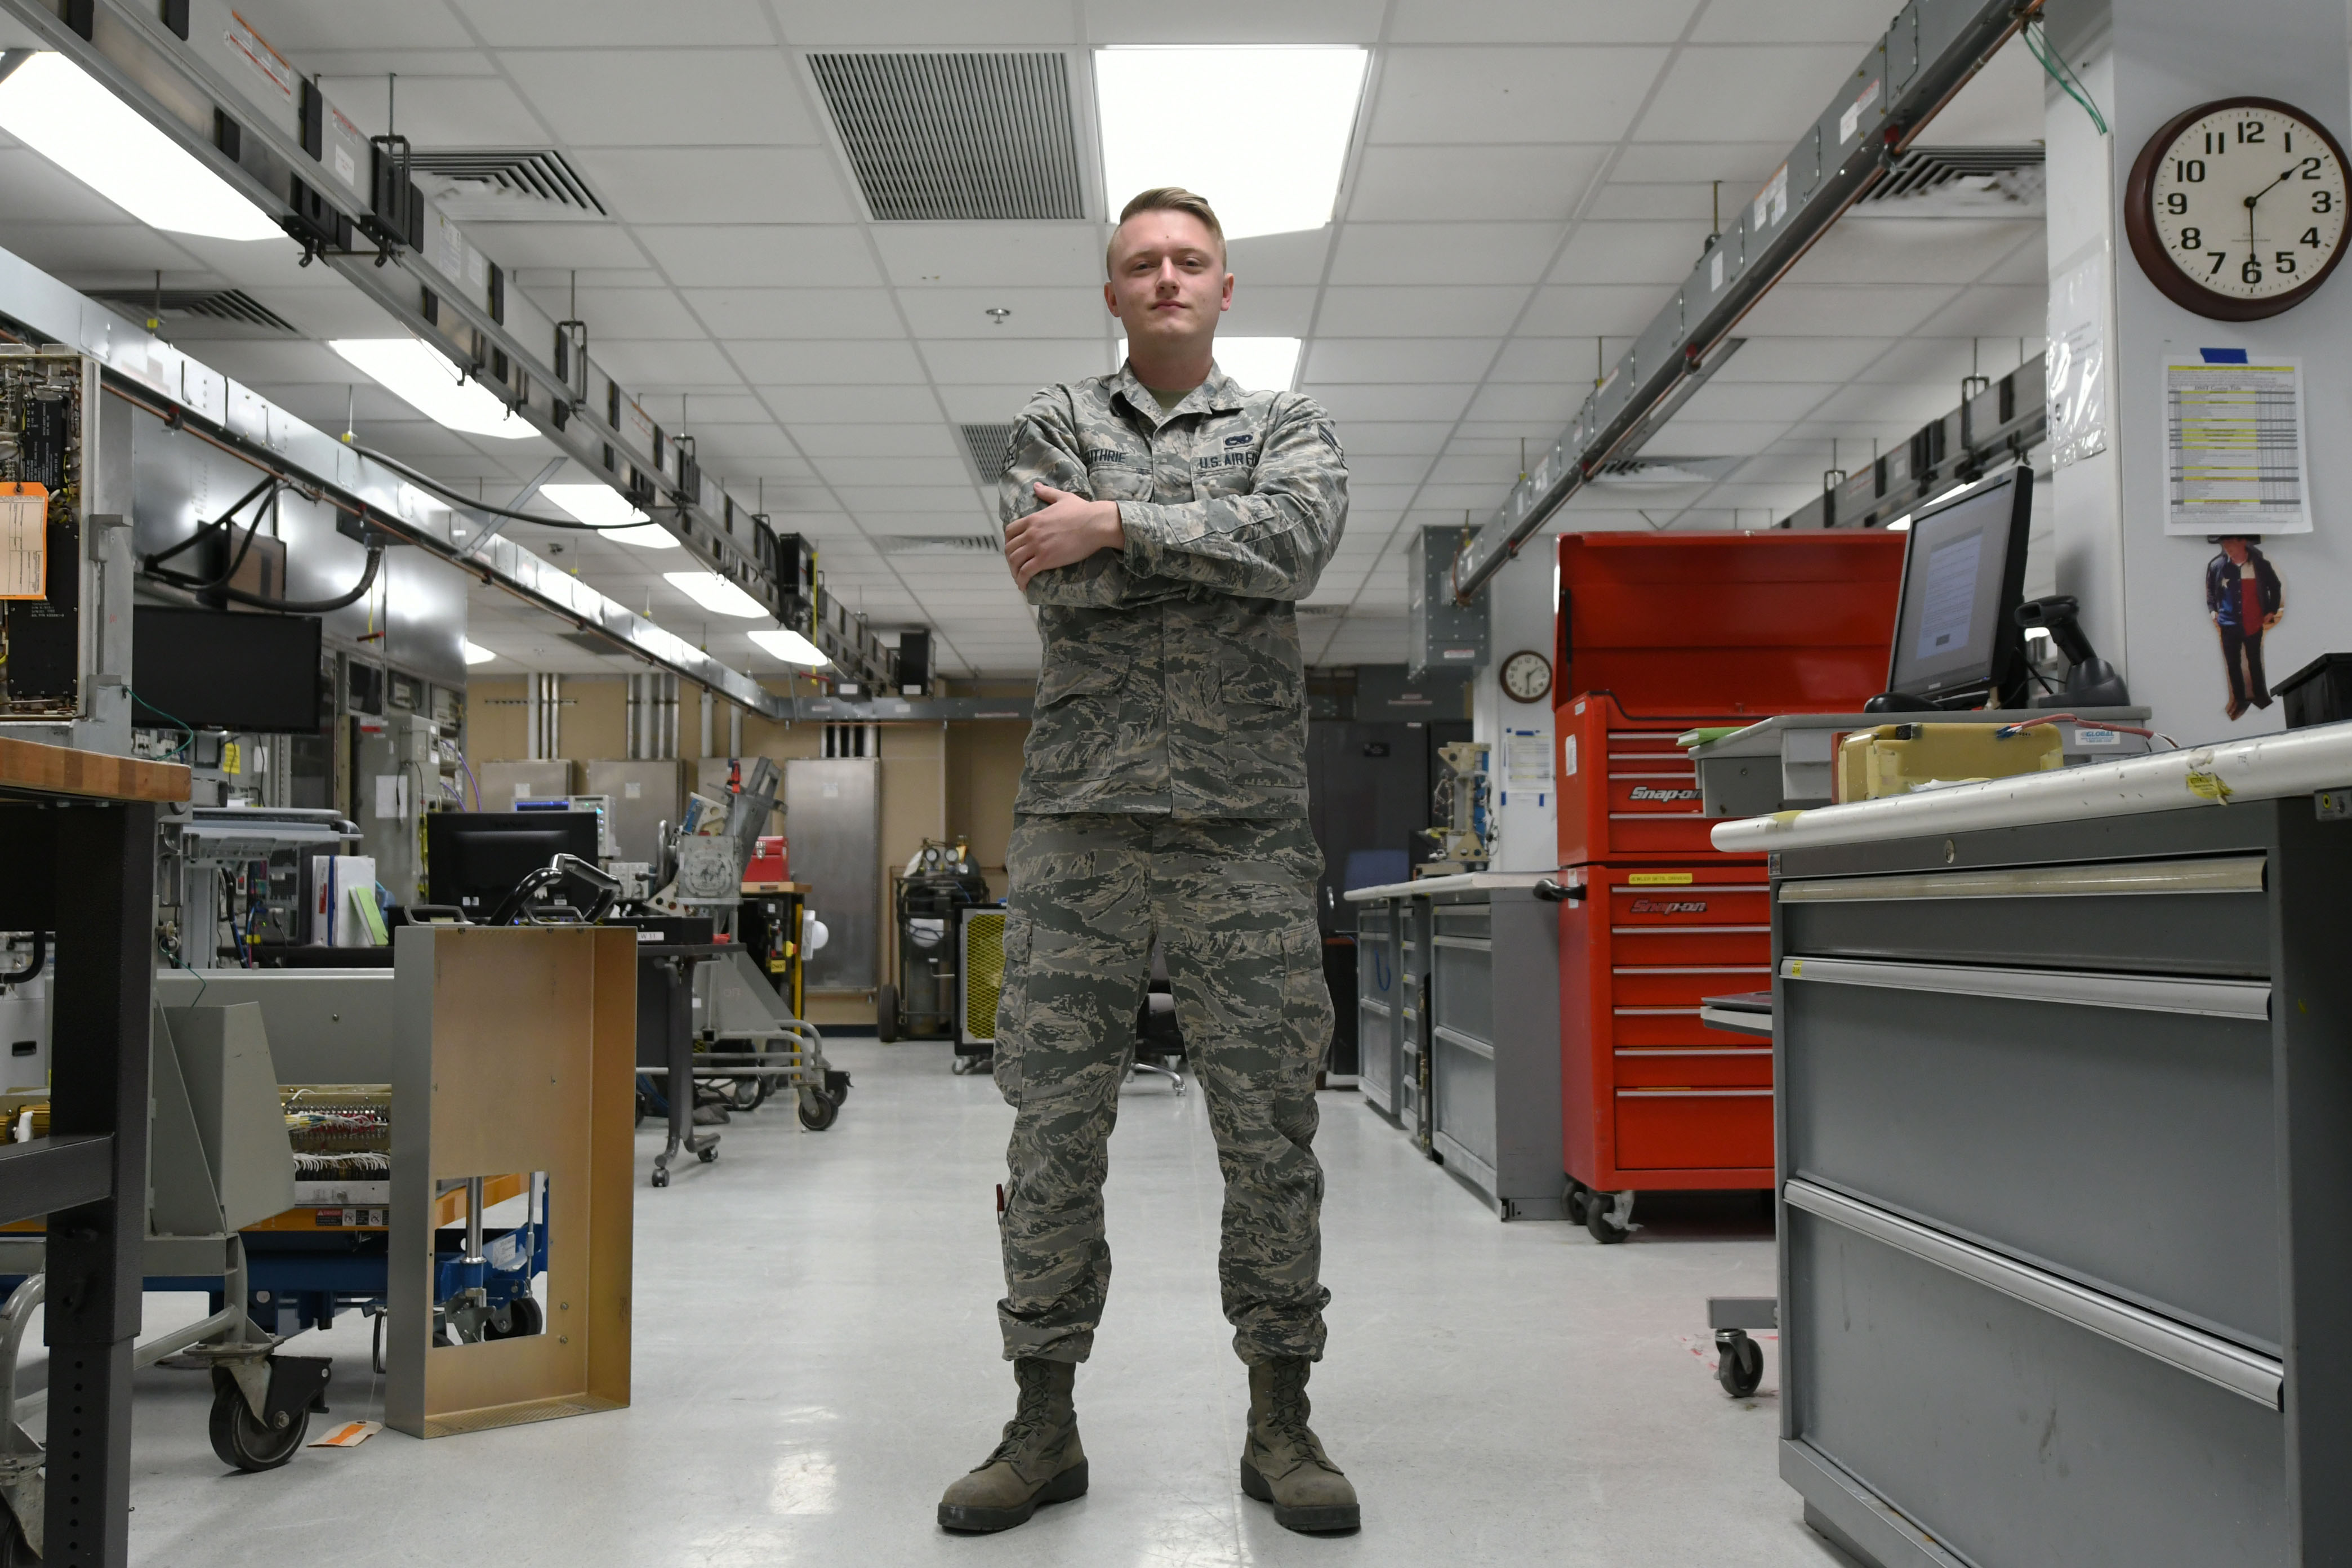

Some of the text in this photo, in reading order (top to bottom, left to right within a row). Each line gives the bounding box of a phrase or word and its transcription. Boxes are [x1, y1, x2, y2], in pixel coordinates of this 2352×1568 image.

[2238, 122, 2265, 142] 12
[2284, 132, 2291, 153] 1
[2206, 132, 2224, 154] 11
[2177, 160, 2205, 182] 10
[2302, 157, 2321, 180] 2
[2167, 193, 2187, 215] 9
[2311, 191, 2331, 213] 3
[2181, 228, 2201, 250] 8
[2300, 227, 2320, 248] 4
[2207, 252, 2226, 274] 7
[2242, 261, 2261, 283] 6
[2276, 252, 2295, 273] 5
[1084, 449, 1127, 464] UTHRIE
[1200, 457, 1222, 468] U.S.
[1225, 453, 1244, 466] AIR
[1631, 787, 1703, 802] Snap-on
[1631, 899, 1707, 915] Snap-on
